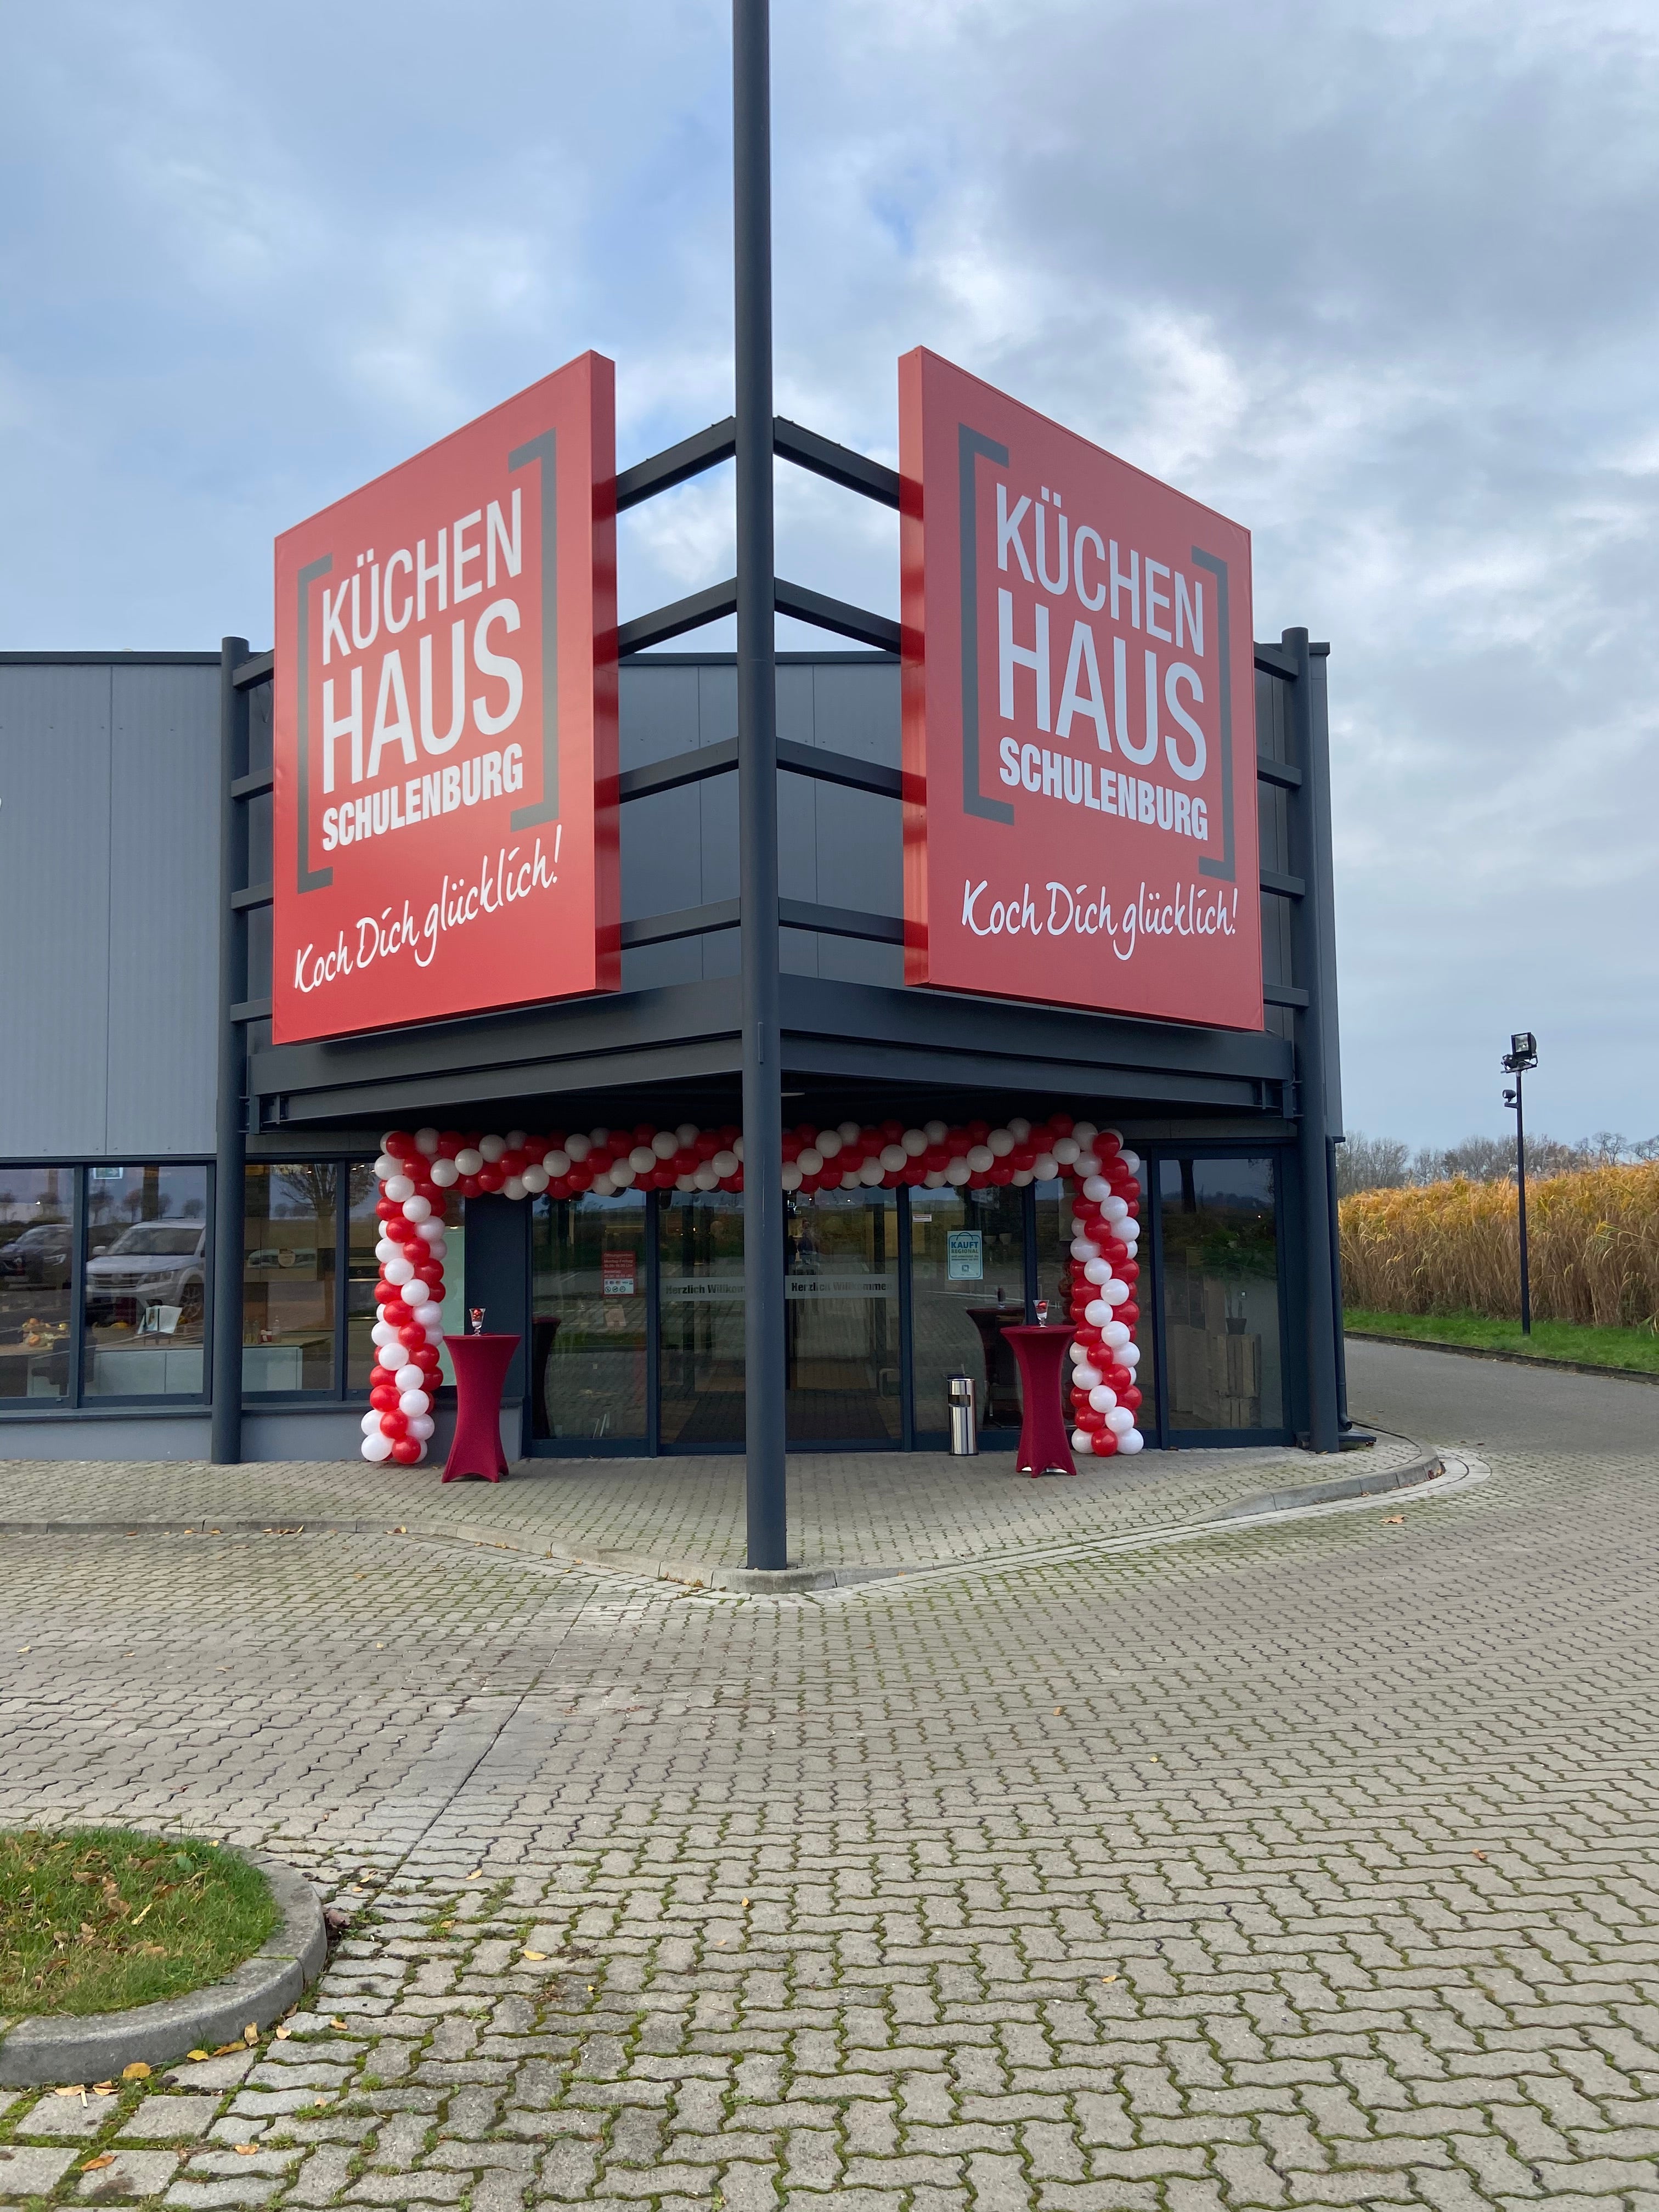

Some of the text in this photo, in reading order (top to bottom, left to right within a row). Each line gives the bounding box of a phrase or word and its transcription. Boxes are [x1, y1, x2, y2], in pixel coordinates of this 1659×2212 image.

[323, 487, 522, 666] KÜCHEN
[996, 483, 1204, 657] KÜCHEN
[322, 597, 524, 794] HAUS
[998, 587, 1207, 781] HAUS
[322, 743, 523, 851] SCHULENBURG
[999, 736, 1208, 842] SCHULENBURG
[294, 824, 563, 994] Koch Dich glücklich!
[961, 879, 1238, 961] Koch Dich glücklich!
[665, 1284, 745, 1294] Herzlich Willkom
[791, 1282, 831, 1291] Herzlich
